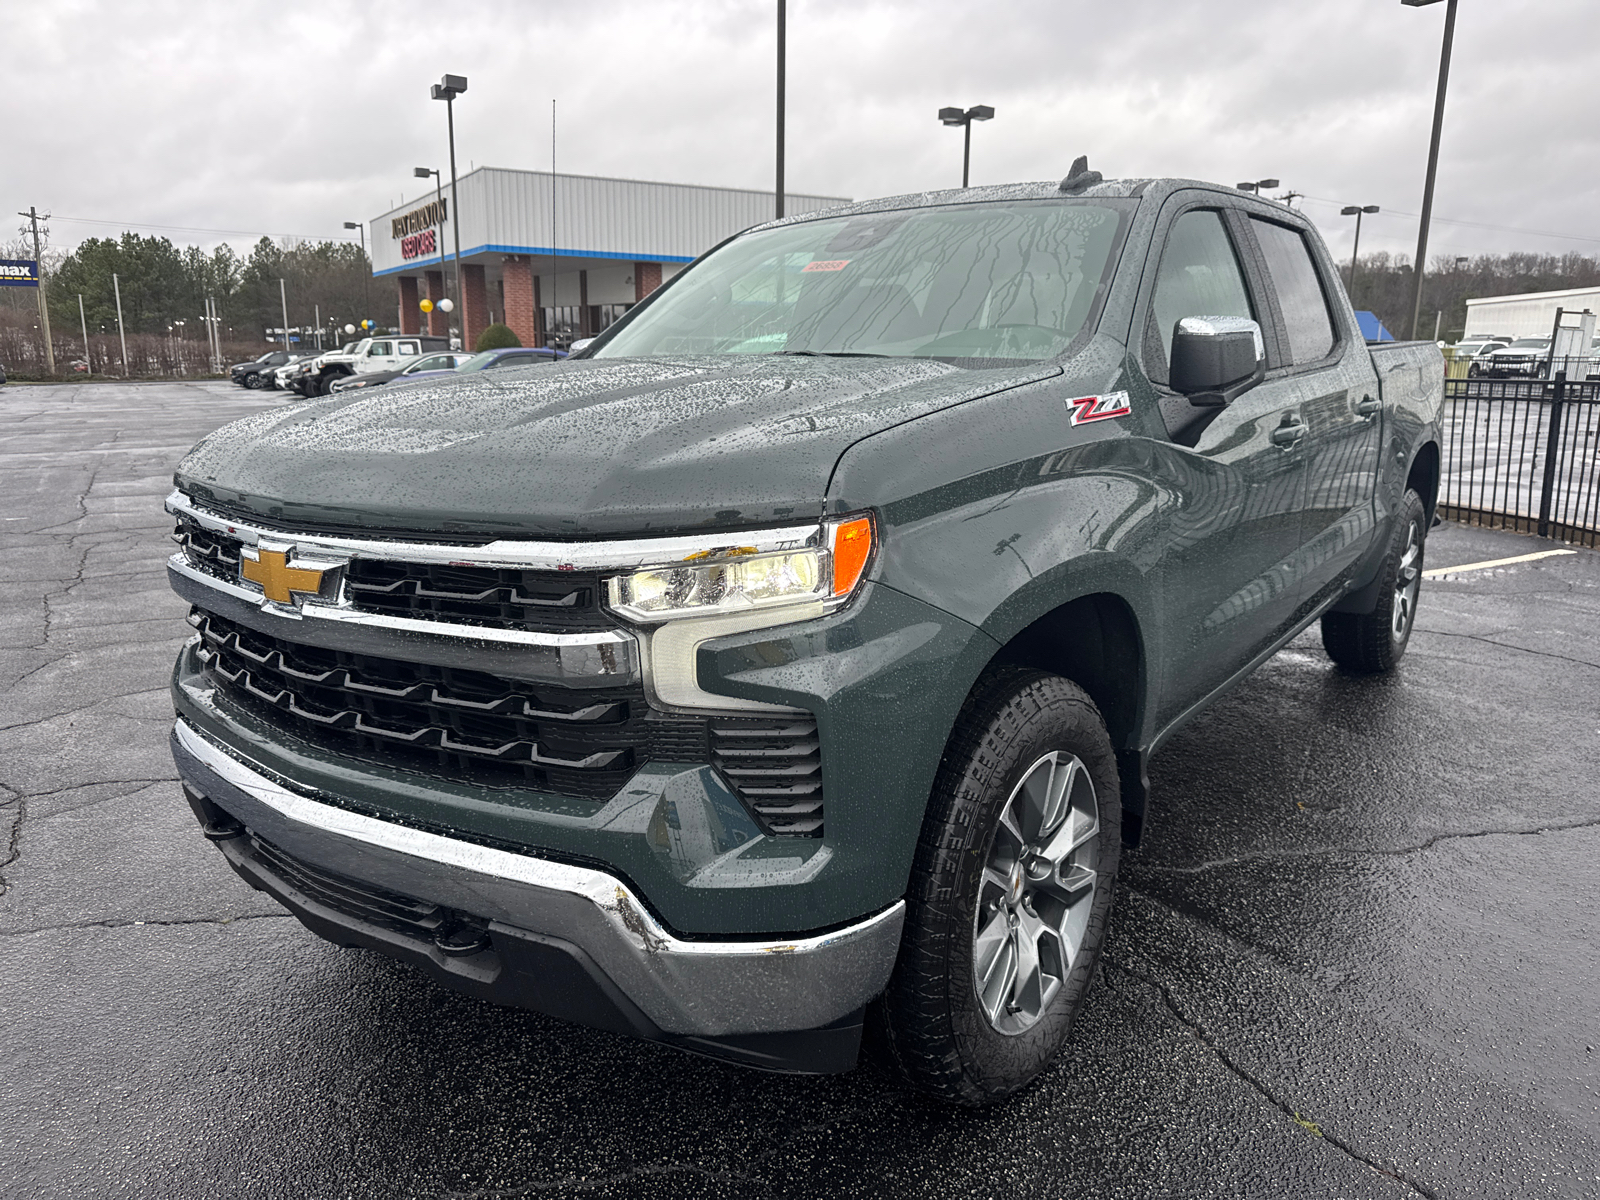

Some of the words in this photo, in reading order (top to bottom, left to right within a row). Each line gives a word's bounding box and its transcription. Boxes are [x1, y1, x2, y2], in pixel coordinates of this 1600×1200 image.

[401, 236, 416, 259] USED
[416, 230, 436, 255] CARS
[1064, 390, 1132, 427] Z71
